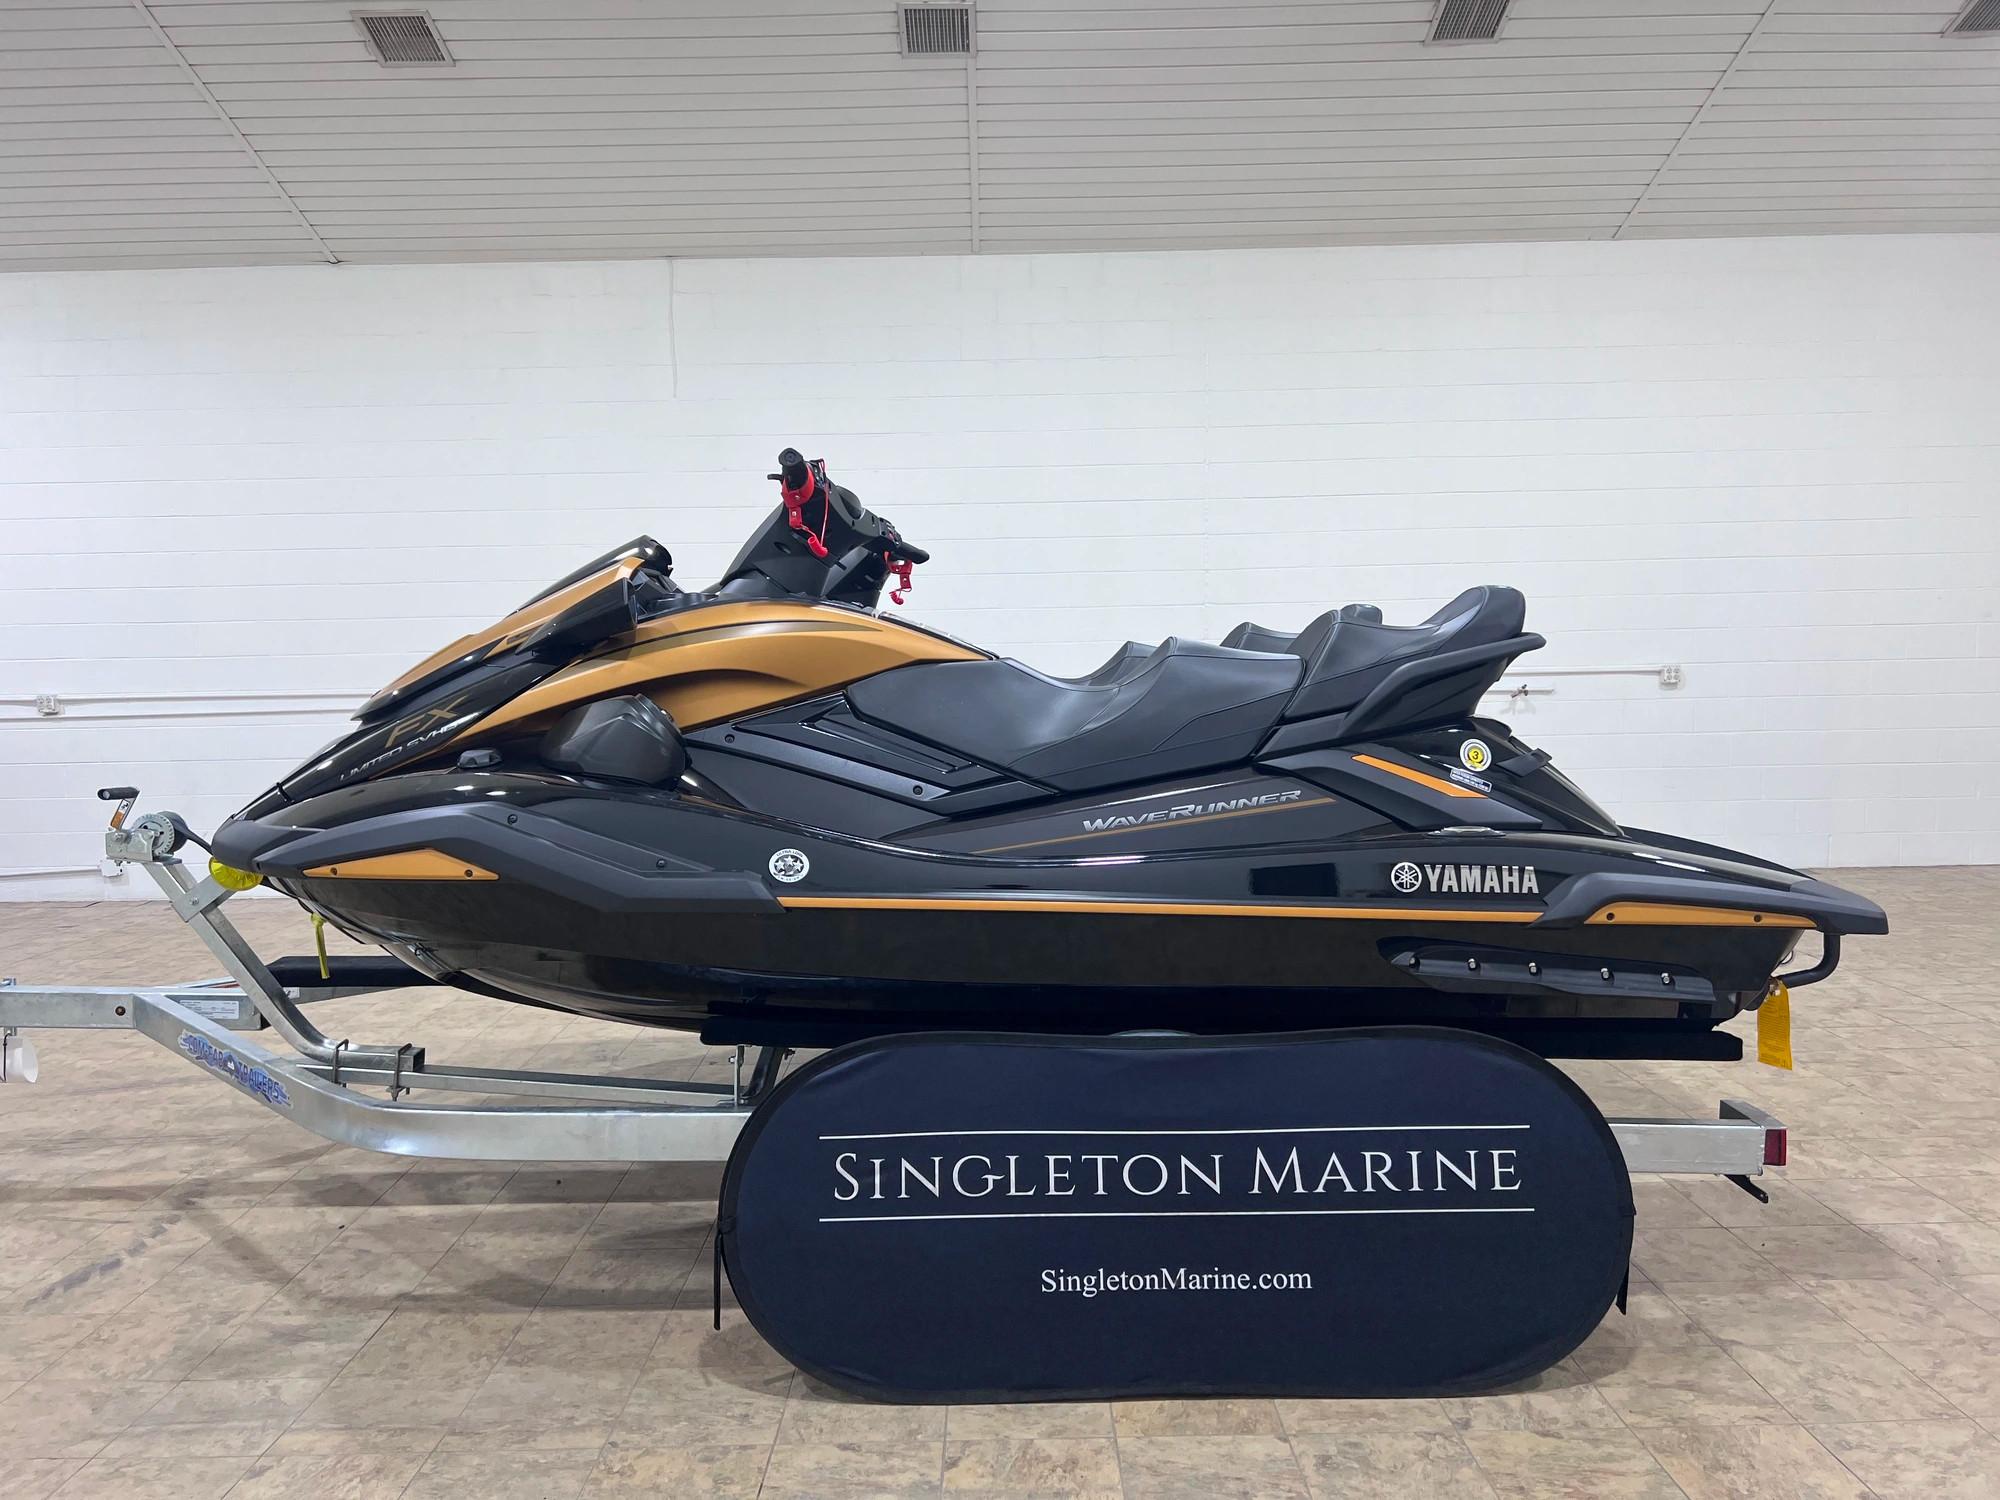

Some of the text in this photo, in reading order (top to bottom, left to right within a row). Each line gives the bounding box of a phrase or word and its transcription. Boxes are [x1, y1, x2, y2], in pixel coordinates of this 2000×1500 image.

[384, 695, 466, 748] FX
[1472, 750, 1479, 760] 3
[1424, 864, 1540, 894] YAMAHA
[834, 1146, 1522, 1201] SINGLETON MARINE
[1041, 1266, 1313, 1298] SingletonMarine.com
